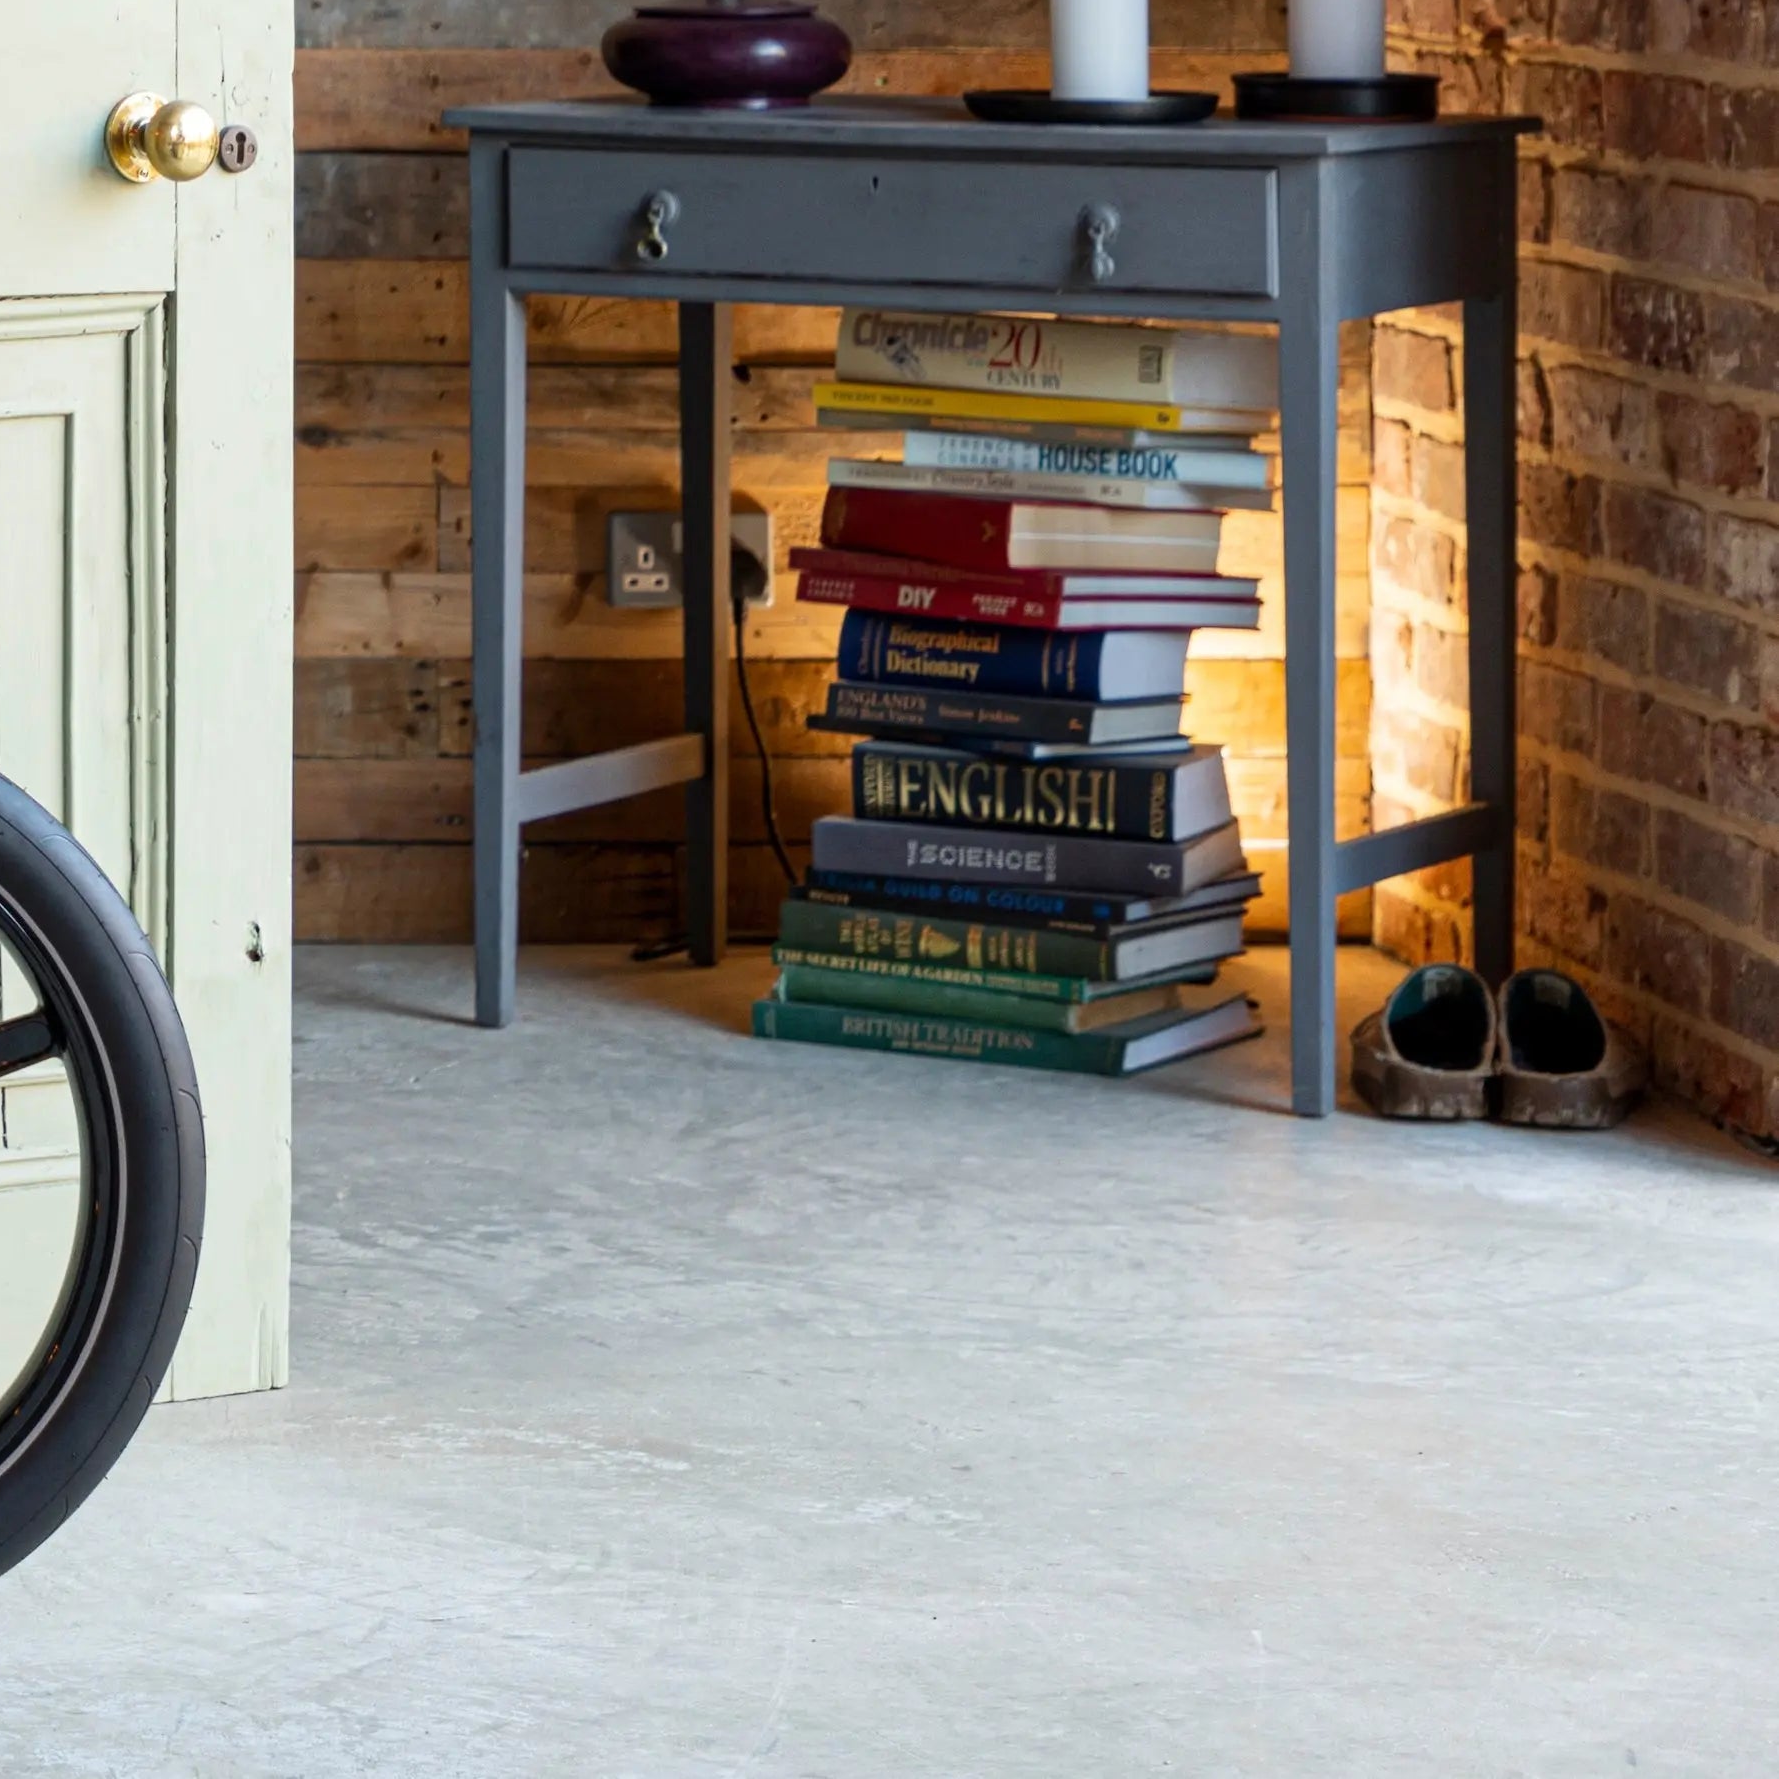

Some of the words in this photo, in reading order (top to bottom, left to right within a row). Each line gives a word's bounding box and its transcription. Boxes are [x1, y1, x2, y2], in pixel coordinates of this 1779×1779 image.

[852, 311, 989, 353] Chronicle
[986, 370, 1062, 391] CENTURY
[1039, 442, 1114, 476] HOUSE
[1117, 451, 1178, 480] BOOK
[898, 585, 936, 609] DIY
[889, 622, 1001, 654] Biographical
[887, 649, 981, 683] Dictionary
[898, 756, 1106, 832] ENGLISH
[919, 844, 1044, 872] SCIENCE
[884, 881, 942, 902] GUILD
[947, 885, 980, 905] ON
[987, 888, 1065, 914] COLOUR
[805, 952, 856, 973] SECRET
[922, 967, 984, 989] GARDEN
[842, 1015, 923, 1040] BRITISH
[924, 1022, 1035, 1051] TRADITION
